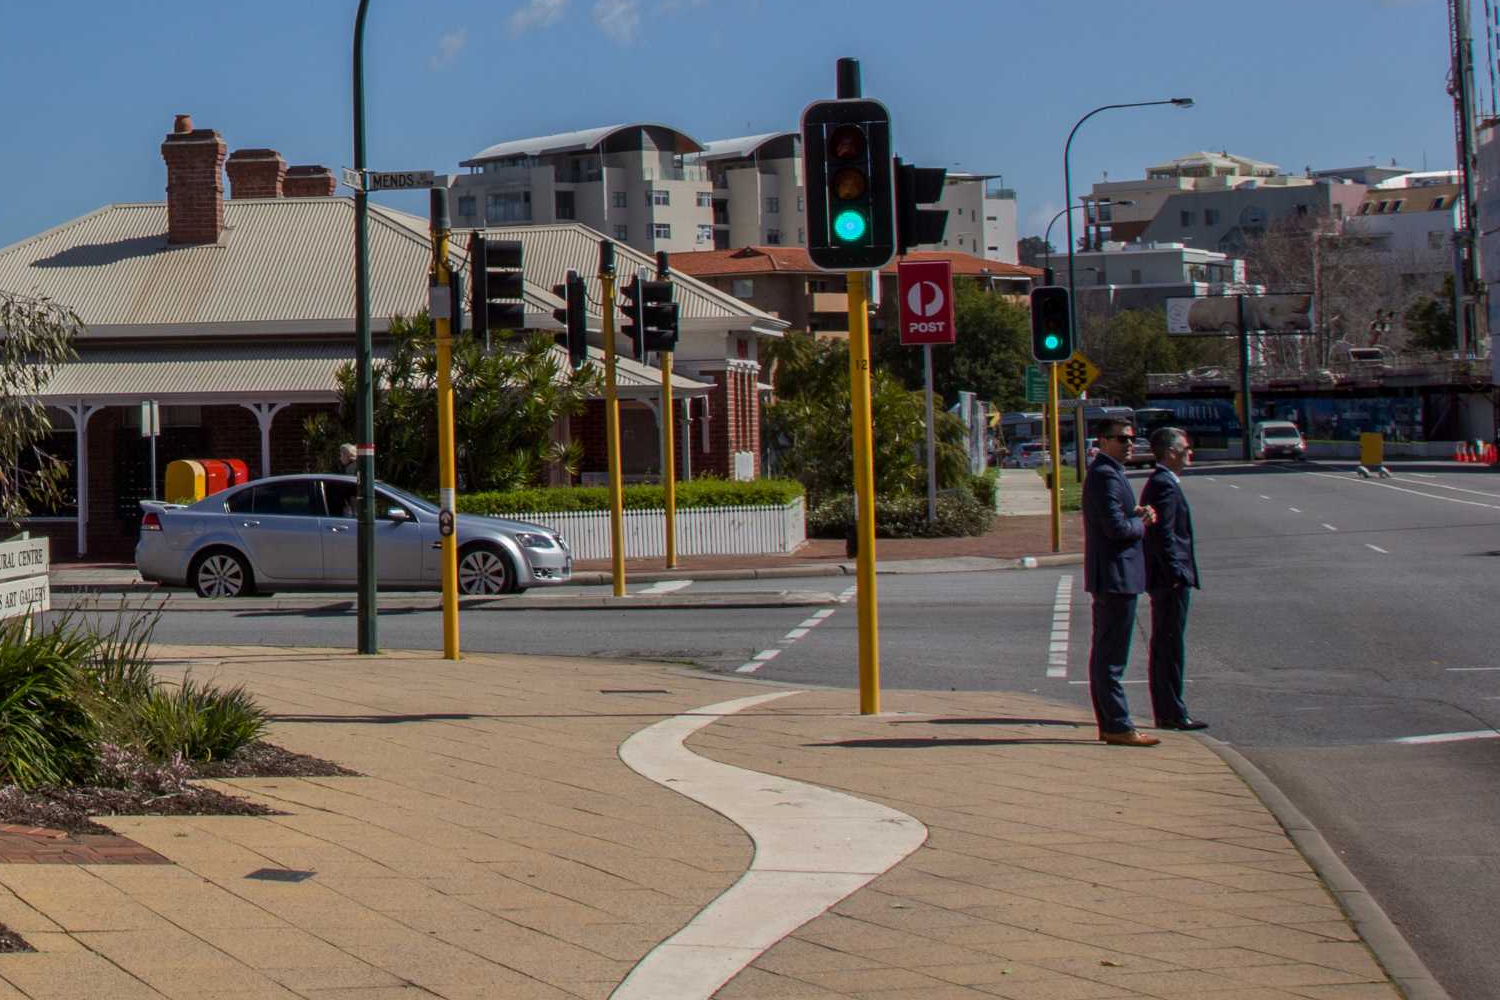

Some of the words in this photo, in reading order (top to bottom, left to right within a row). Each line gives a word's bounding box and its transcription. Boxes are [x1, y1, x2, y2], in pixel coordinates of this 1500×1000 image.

[372, 174, 413, 187] MENDS
[909, 322, 945, 333] POST
[18, 549, 43, 567] CENTRE
[5, 591, 17, 608] ART
[19, 586, 46, 605] GALLERY
